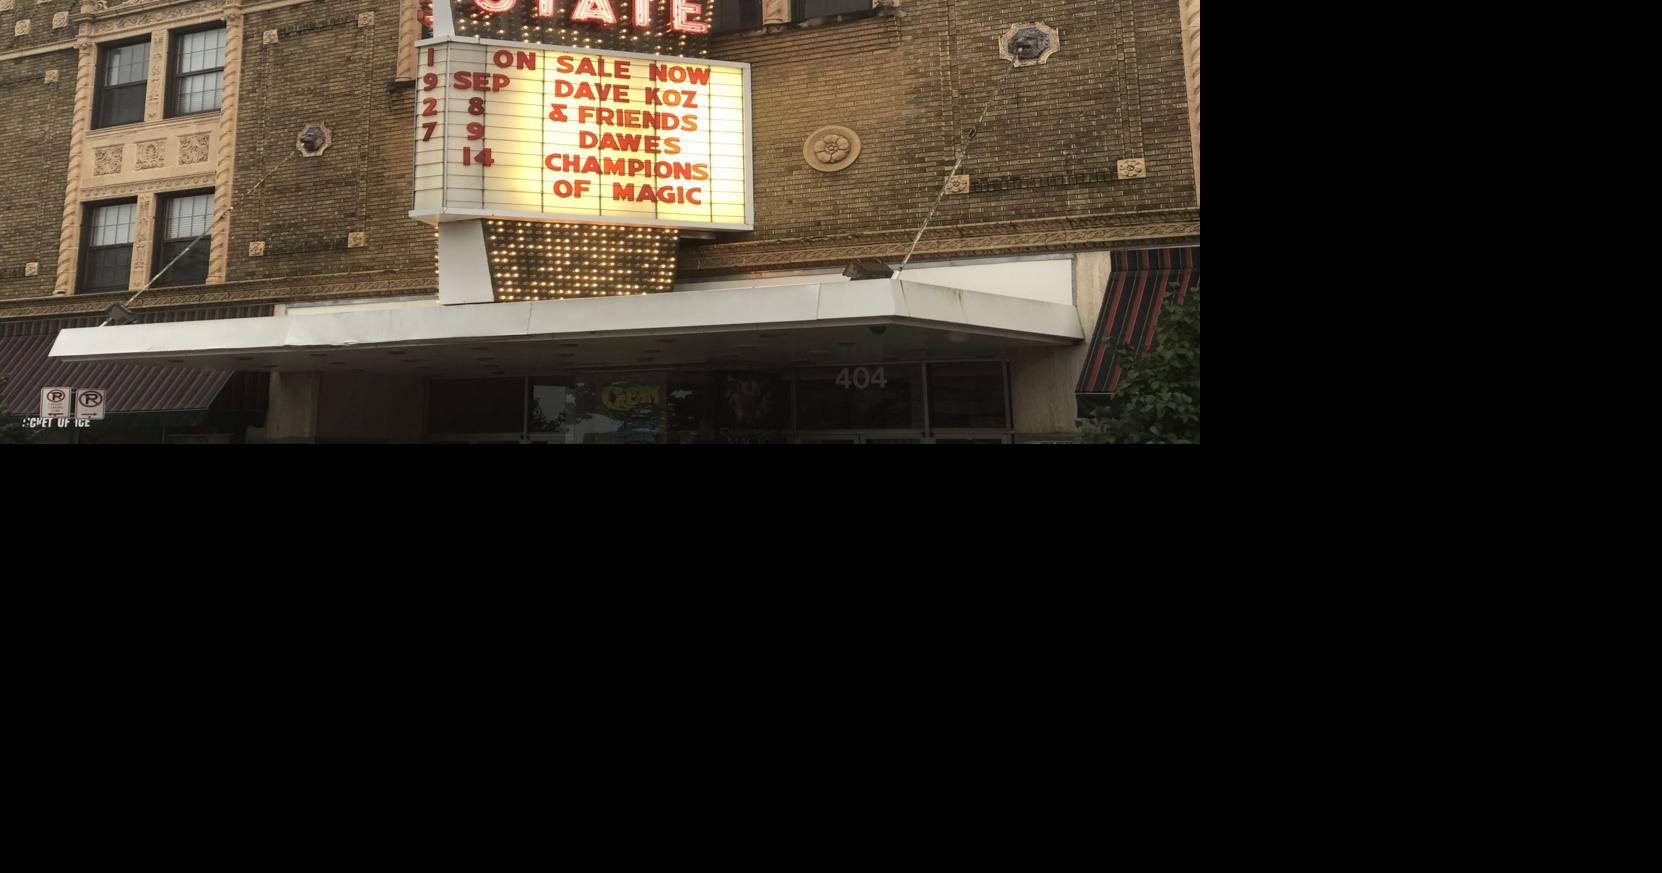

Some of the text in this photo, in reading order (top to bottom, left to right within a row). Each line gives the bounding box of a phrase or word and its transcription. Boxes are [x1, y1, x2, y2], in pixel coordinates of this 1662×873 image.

[493, 50, 711, 86] ON SALE NOW
[453, 71, 698, 109] SEP DAVE KOZ
[467, 97, 698, 132] 8 & FRIENDS
[466, 122, 681, 155] 9 DAWES
[462, 146, 709, 181] 14 CHAMPIONS
[553, 179, 702, 205] OF MAGIC
[835, 366, 888, 389] 404
